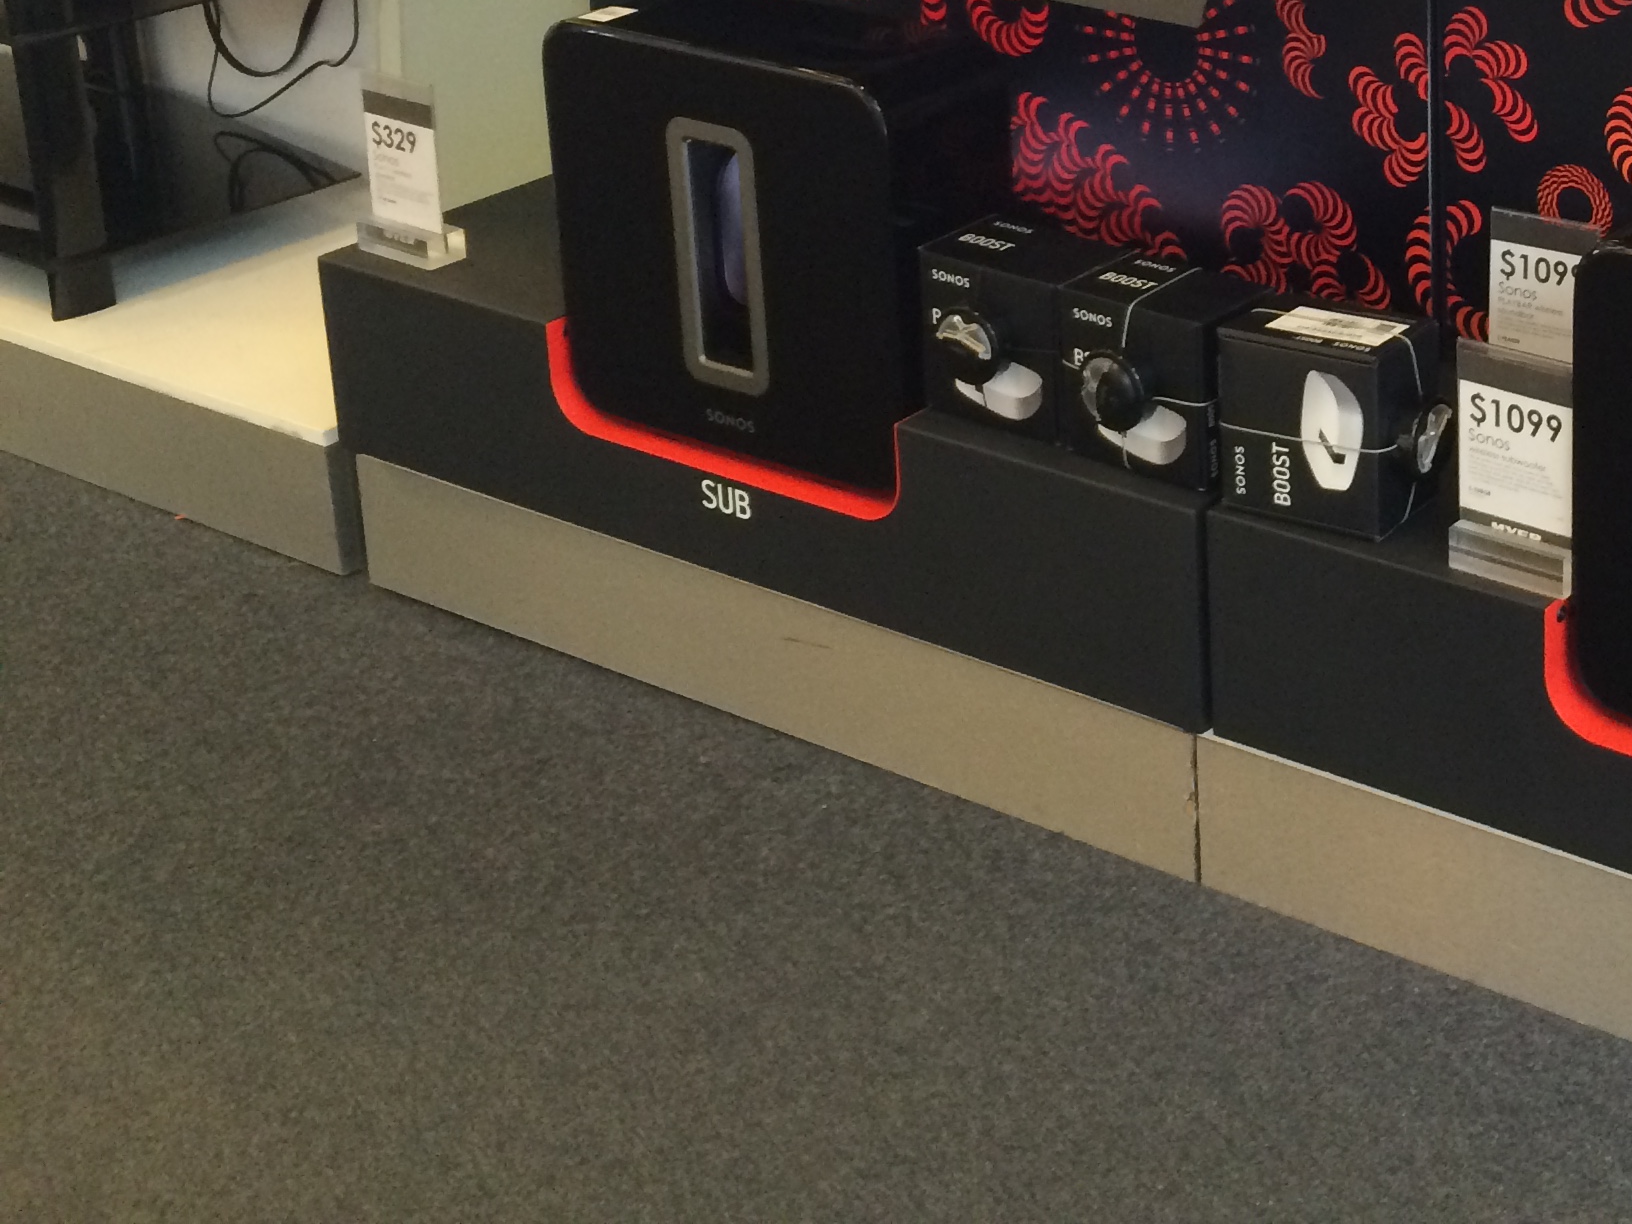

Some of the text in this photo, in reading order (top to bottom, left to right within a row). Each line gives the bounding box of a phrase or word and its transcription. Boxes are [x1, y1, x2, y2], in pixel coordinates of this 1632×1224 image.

[371, 120, 417, 154] $329
[992, 219, 1035, 236] SONOS
[957, 232, 1017, 253] BOOST
[1133, 258, 1177, 274] SONOS
[931, 268, 971, 289] SONOS
[1097, 270, 1159, 291] BOOST
[1497, 280, 1538, 302] Sonos
[1072, 306, 1113, 329] SONOS
[705, 407, 756, 434] SONOS
[1469, 391, 1563, 444] $1099
[1467, 427, 1511, 453] Sonos
[1233, 444, 1247, 496] SONOS
[1270, 441, 1293, 508] BOOST
[700, 478, 752, 520] SUB
